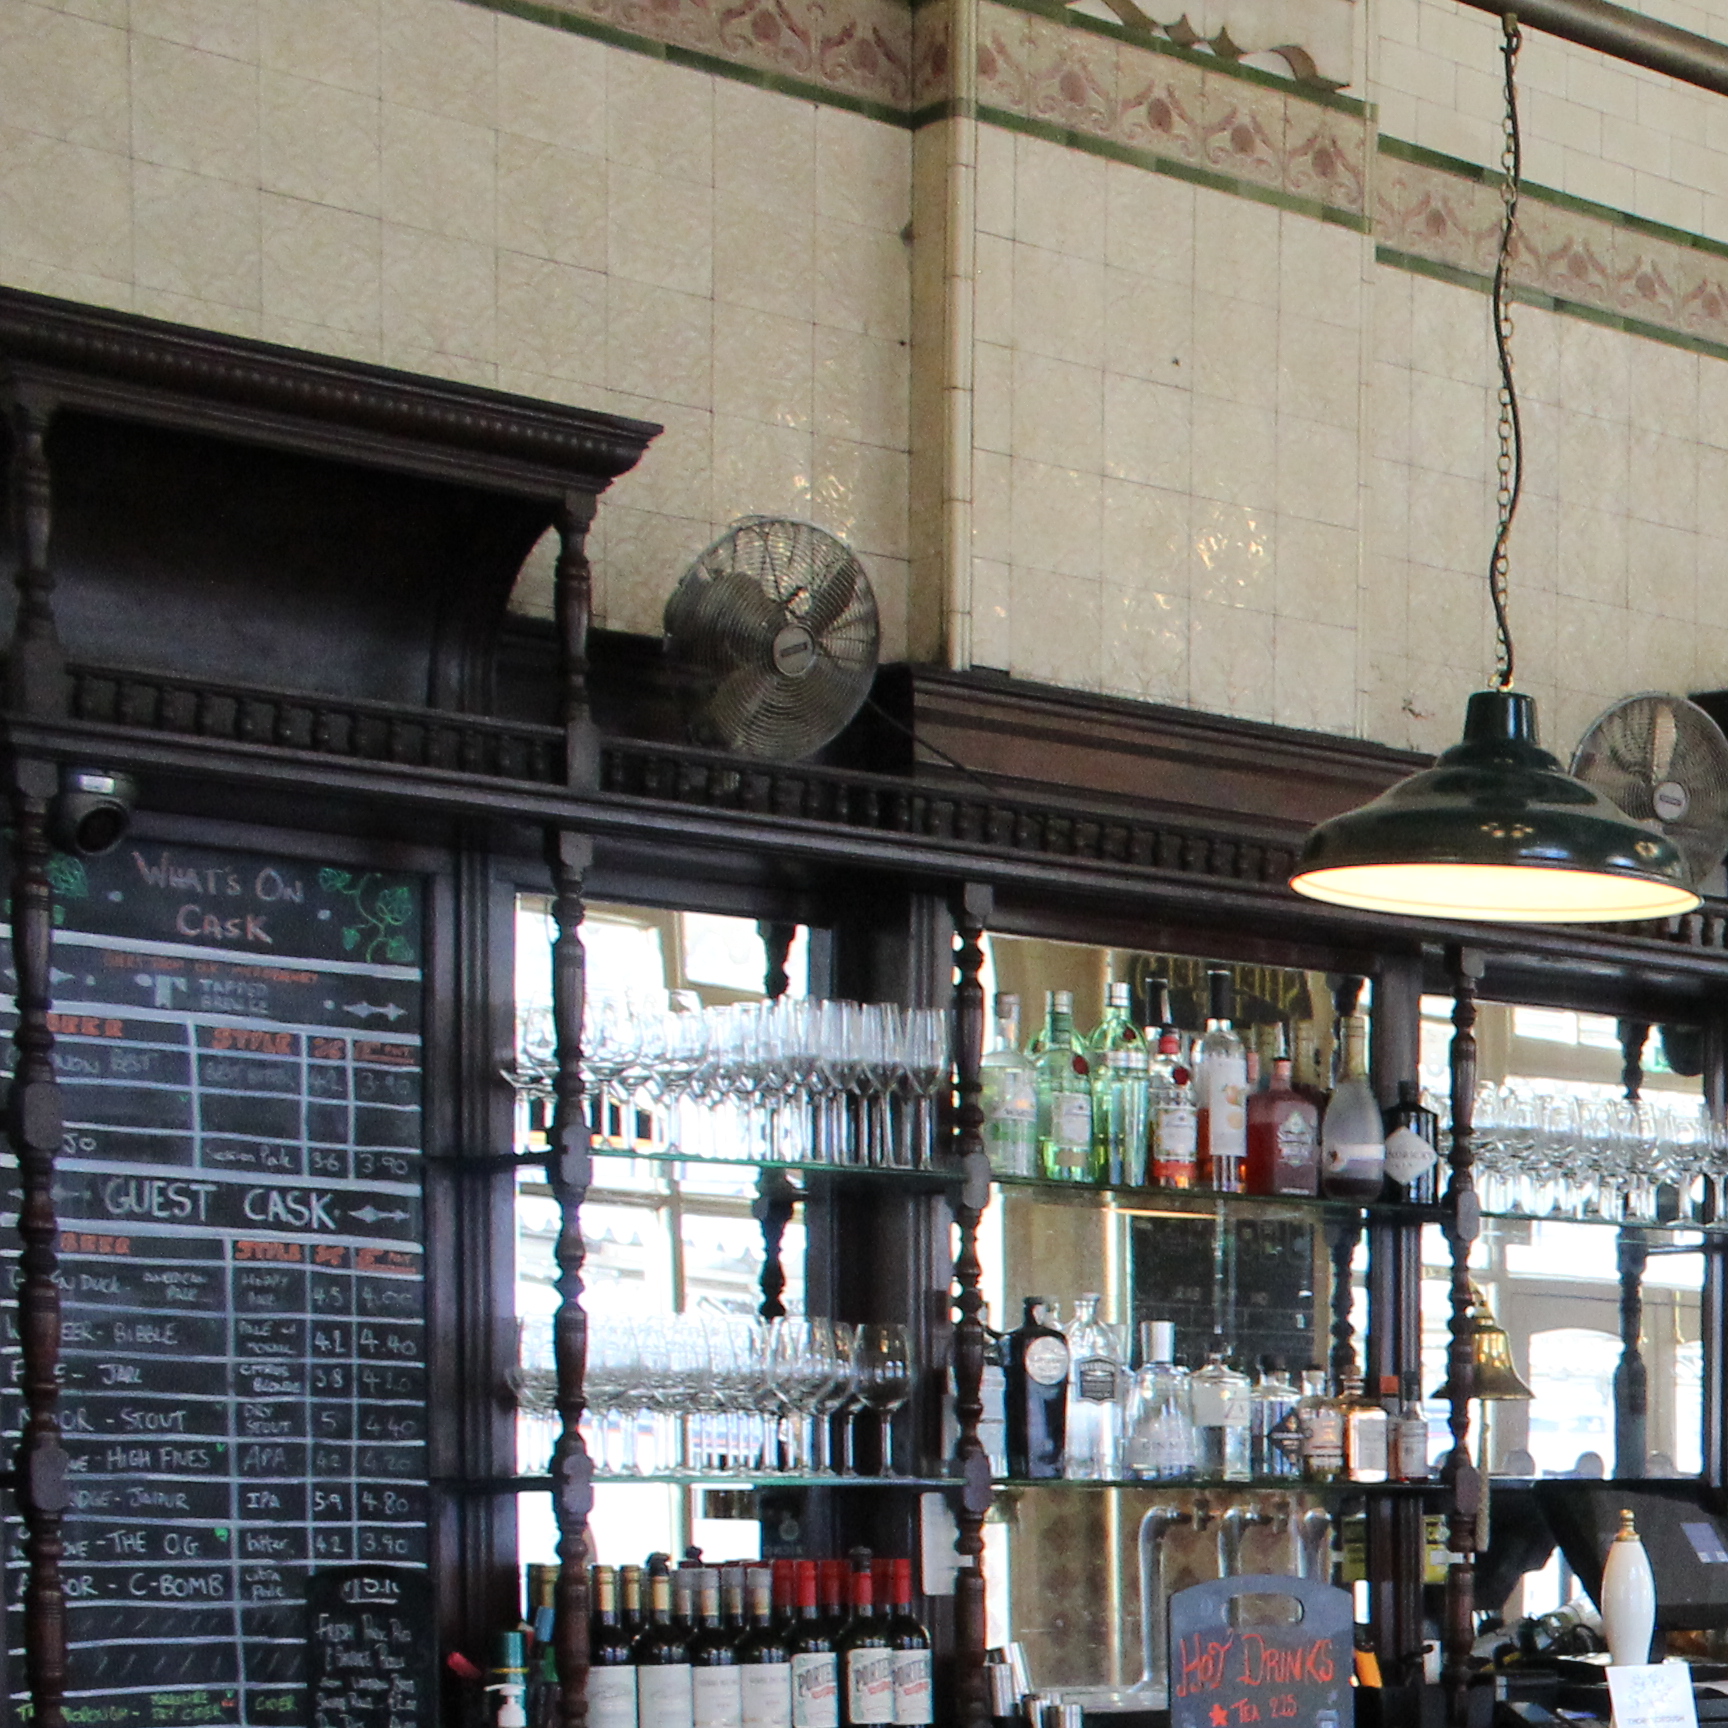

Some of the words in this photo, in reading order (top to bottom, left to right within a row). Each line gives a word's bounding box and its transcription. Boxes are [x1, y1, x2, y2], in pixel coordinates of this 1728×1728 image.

[131, 852, 241, 897] WHAT'S
[254, 867, 305, 904] ON
[175, 904, 273, 944] CASK
[105, 1177, 217, 1222] GUEST
[243, 1188, 336, 1230] CASK
[1177, 1628, 1234, 1697] HOT
[1237, 1633, 1335, 1686] DRINKS
